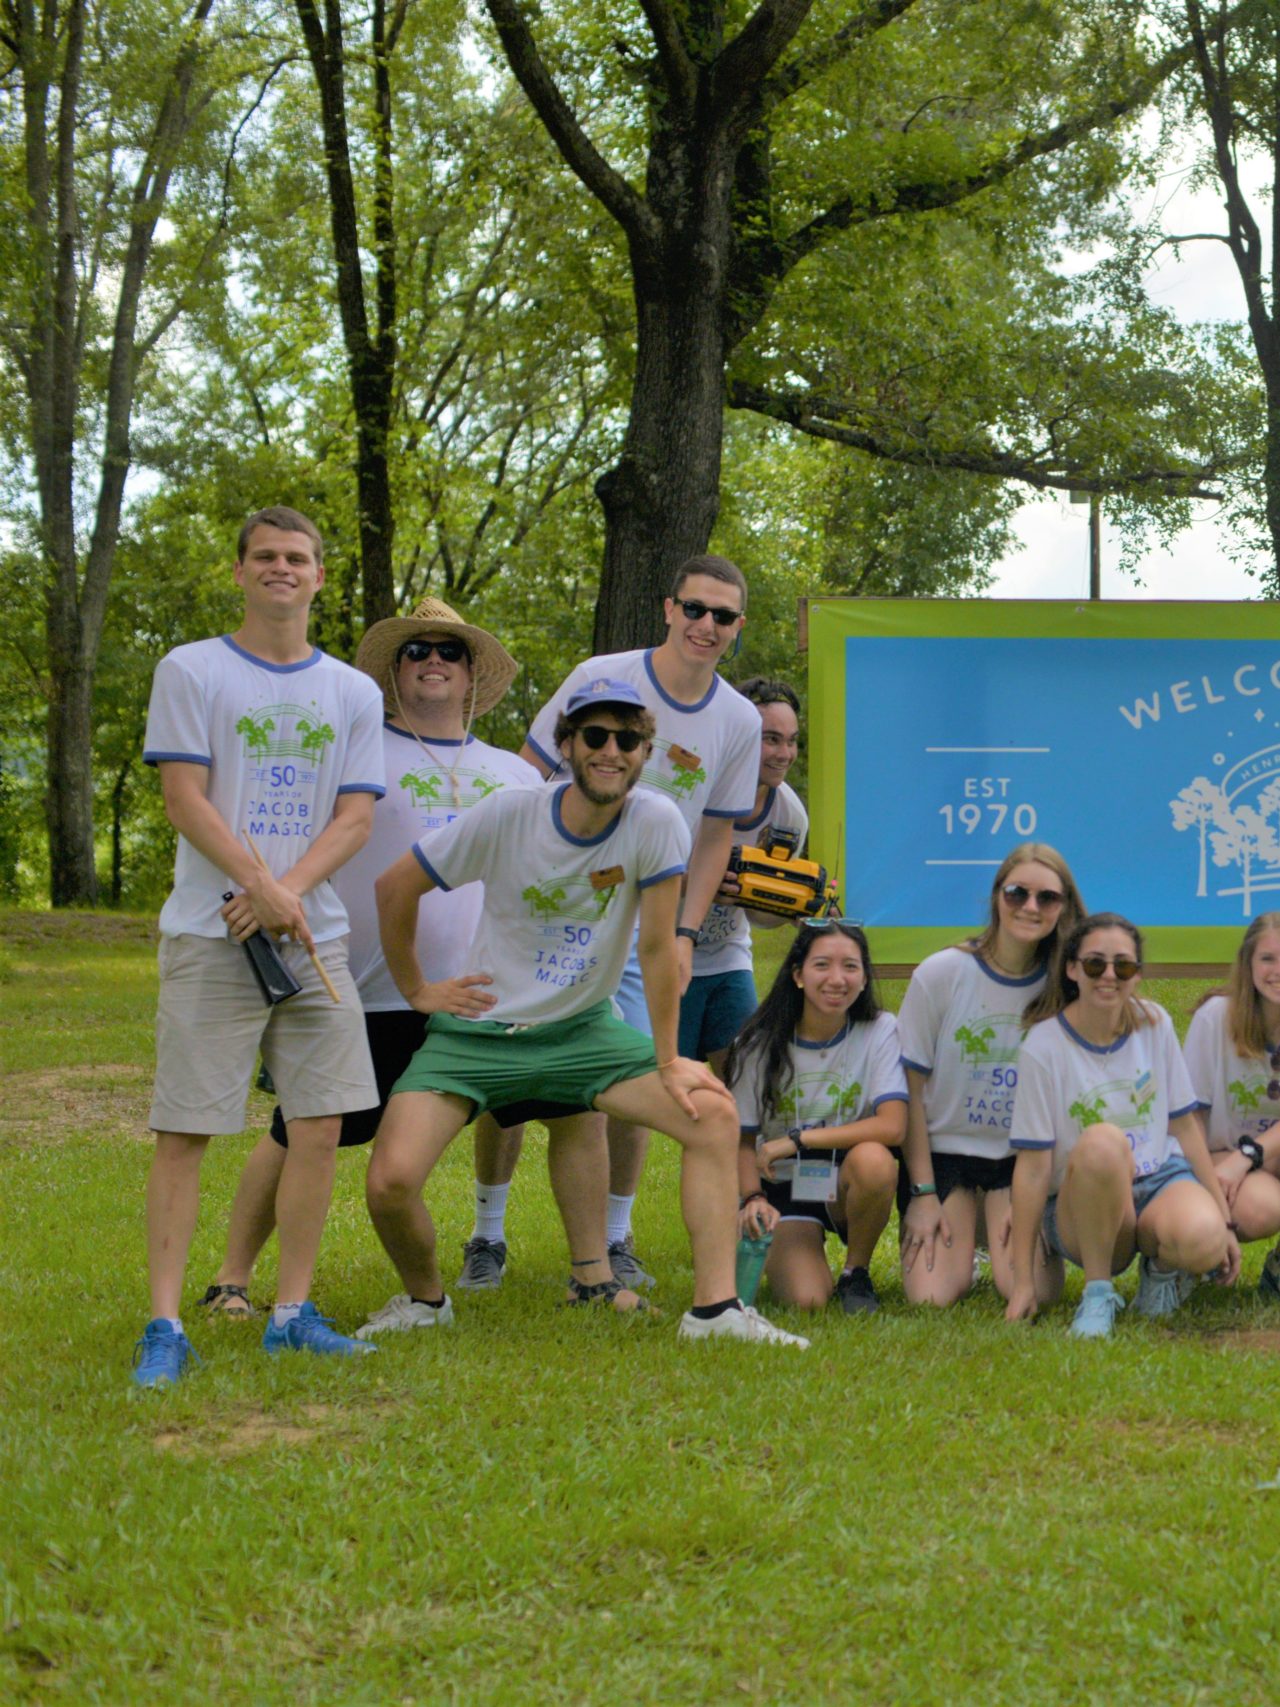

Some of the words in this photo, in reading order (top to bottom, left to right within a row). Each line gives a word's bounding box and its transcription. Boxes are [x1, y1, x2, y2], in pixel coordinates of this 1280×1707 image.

[270, 765, 296, 787] 50
[964, 778, 1011, 798] EST
[250, 822, 312, 837] MAGIC
[939, 803, 1037, 836] 1970
[564, 925, 591, 946] 50
[535, 951, 597, 971] JACOBS
[991, 1068, 1018, 1088] 50
